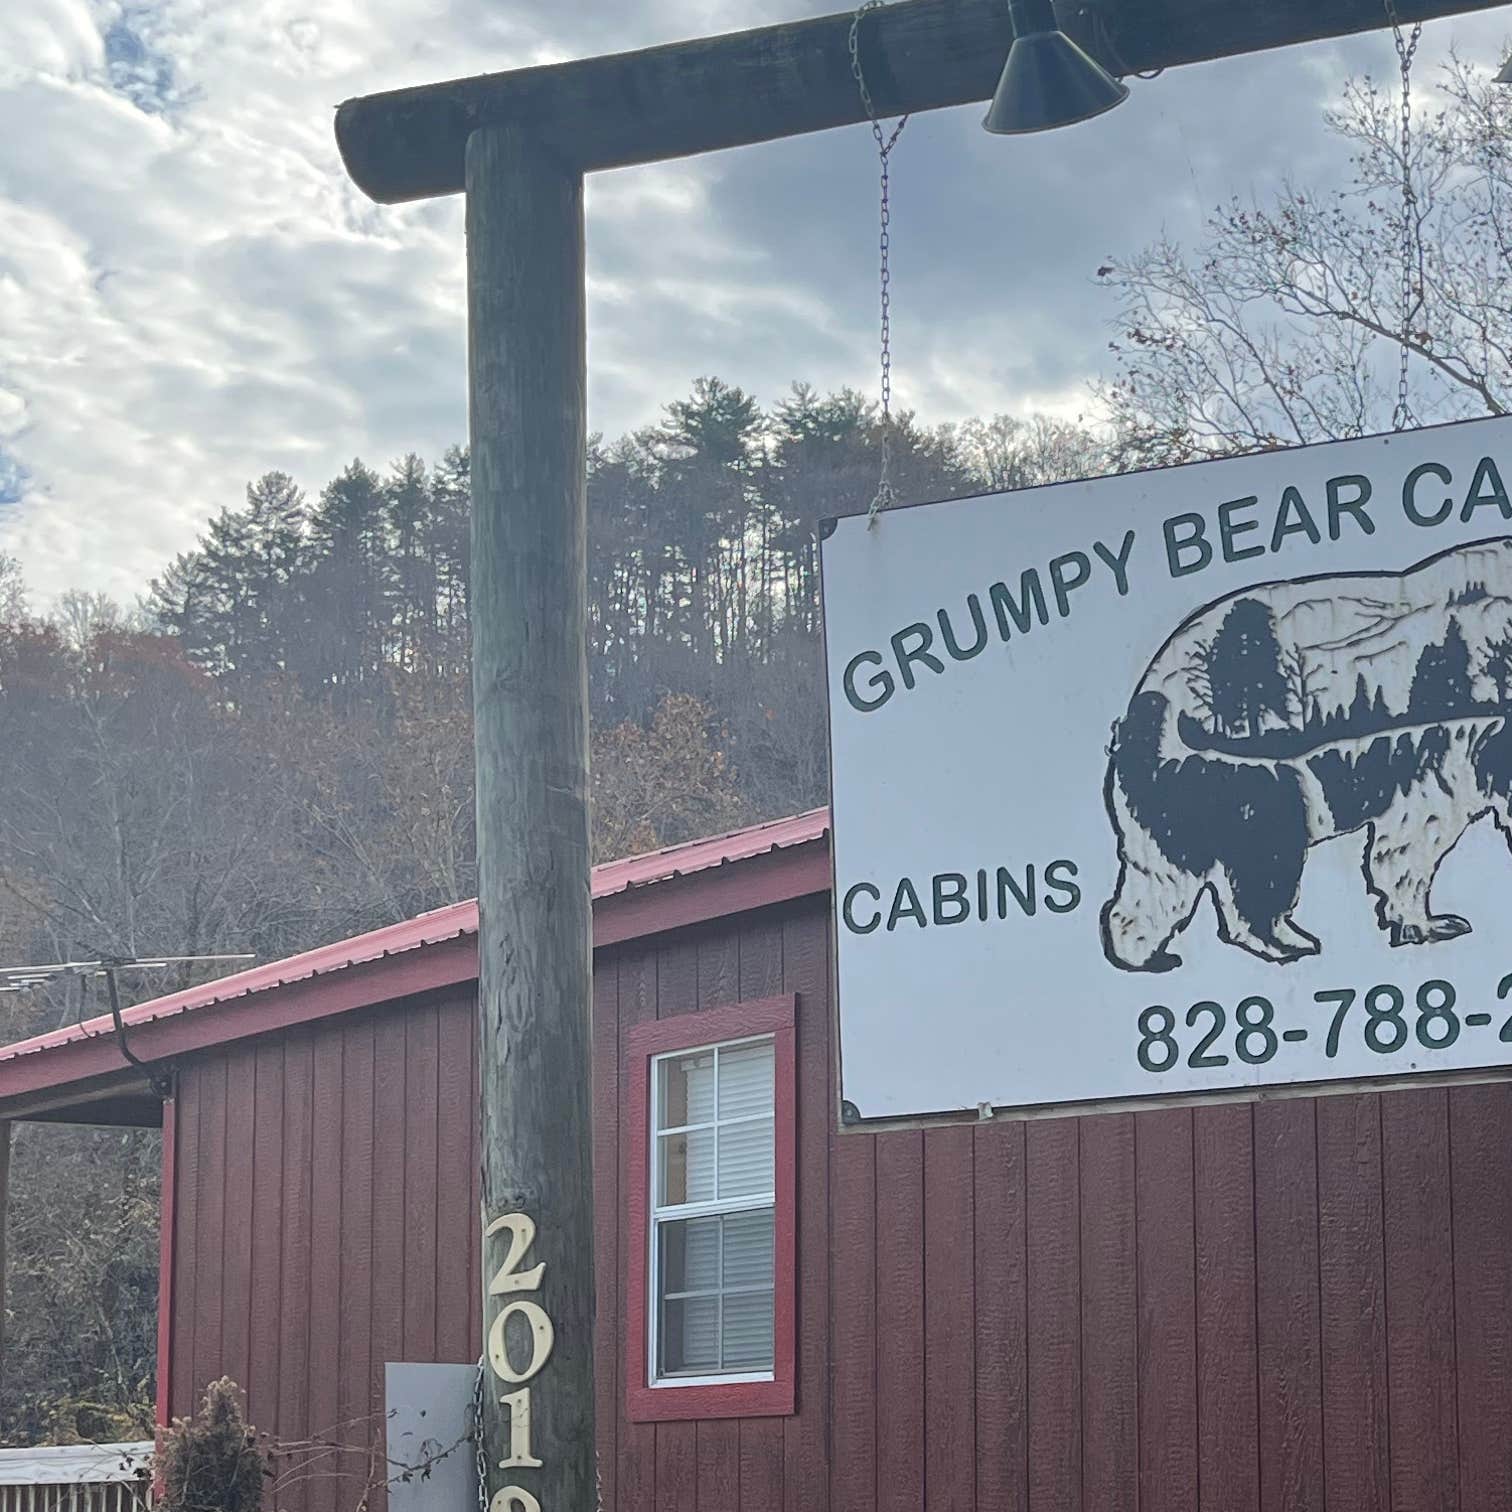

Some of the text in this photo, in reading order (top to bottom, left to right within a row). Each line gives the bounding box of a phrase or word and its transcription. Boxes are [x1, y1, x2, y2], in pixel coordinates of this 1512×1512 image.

[843, 530, 1136, 713] GRUMPY
[1163, 474, 1376, 578] BEAR
[842, 859, 1083, 935] CABINS
